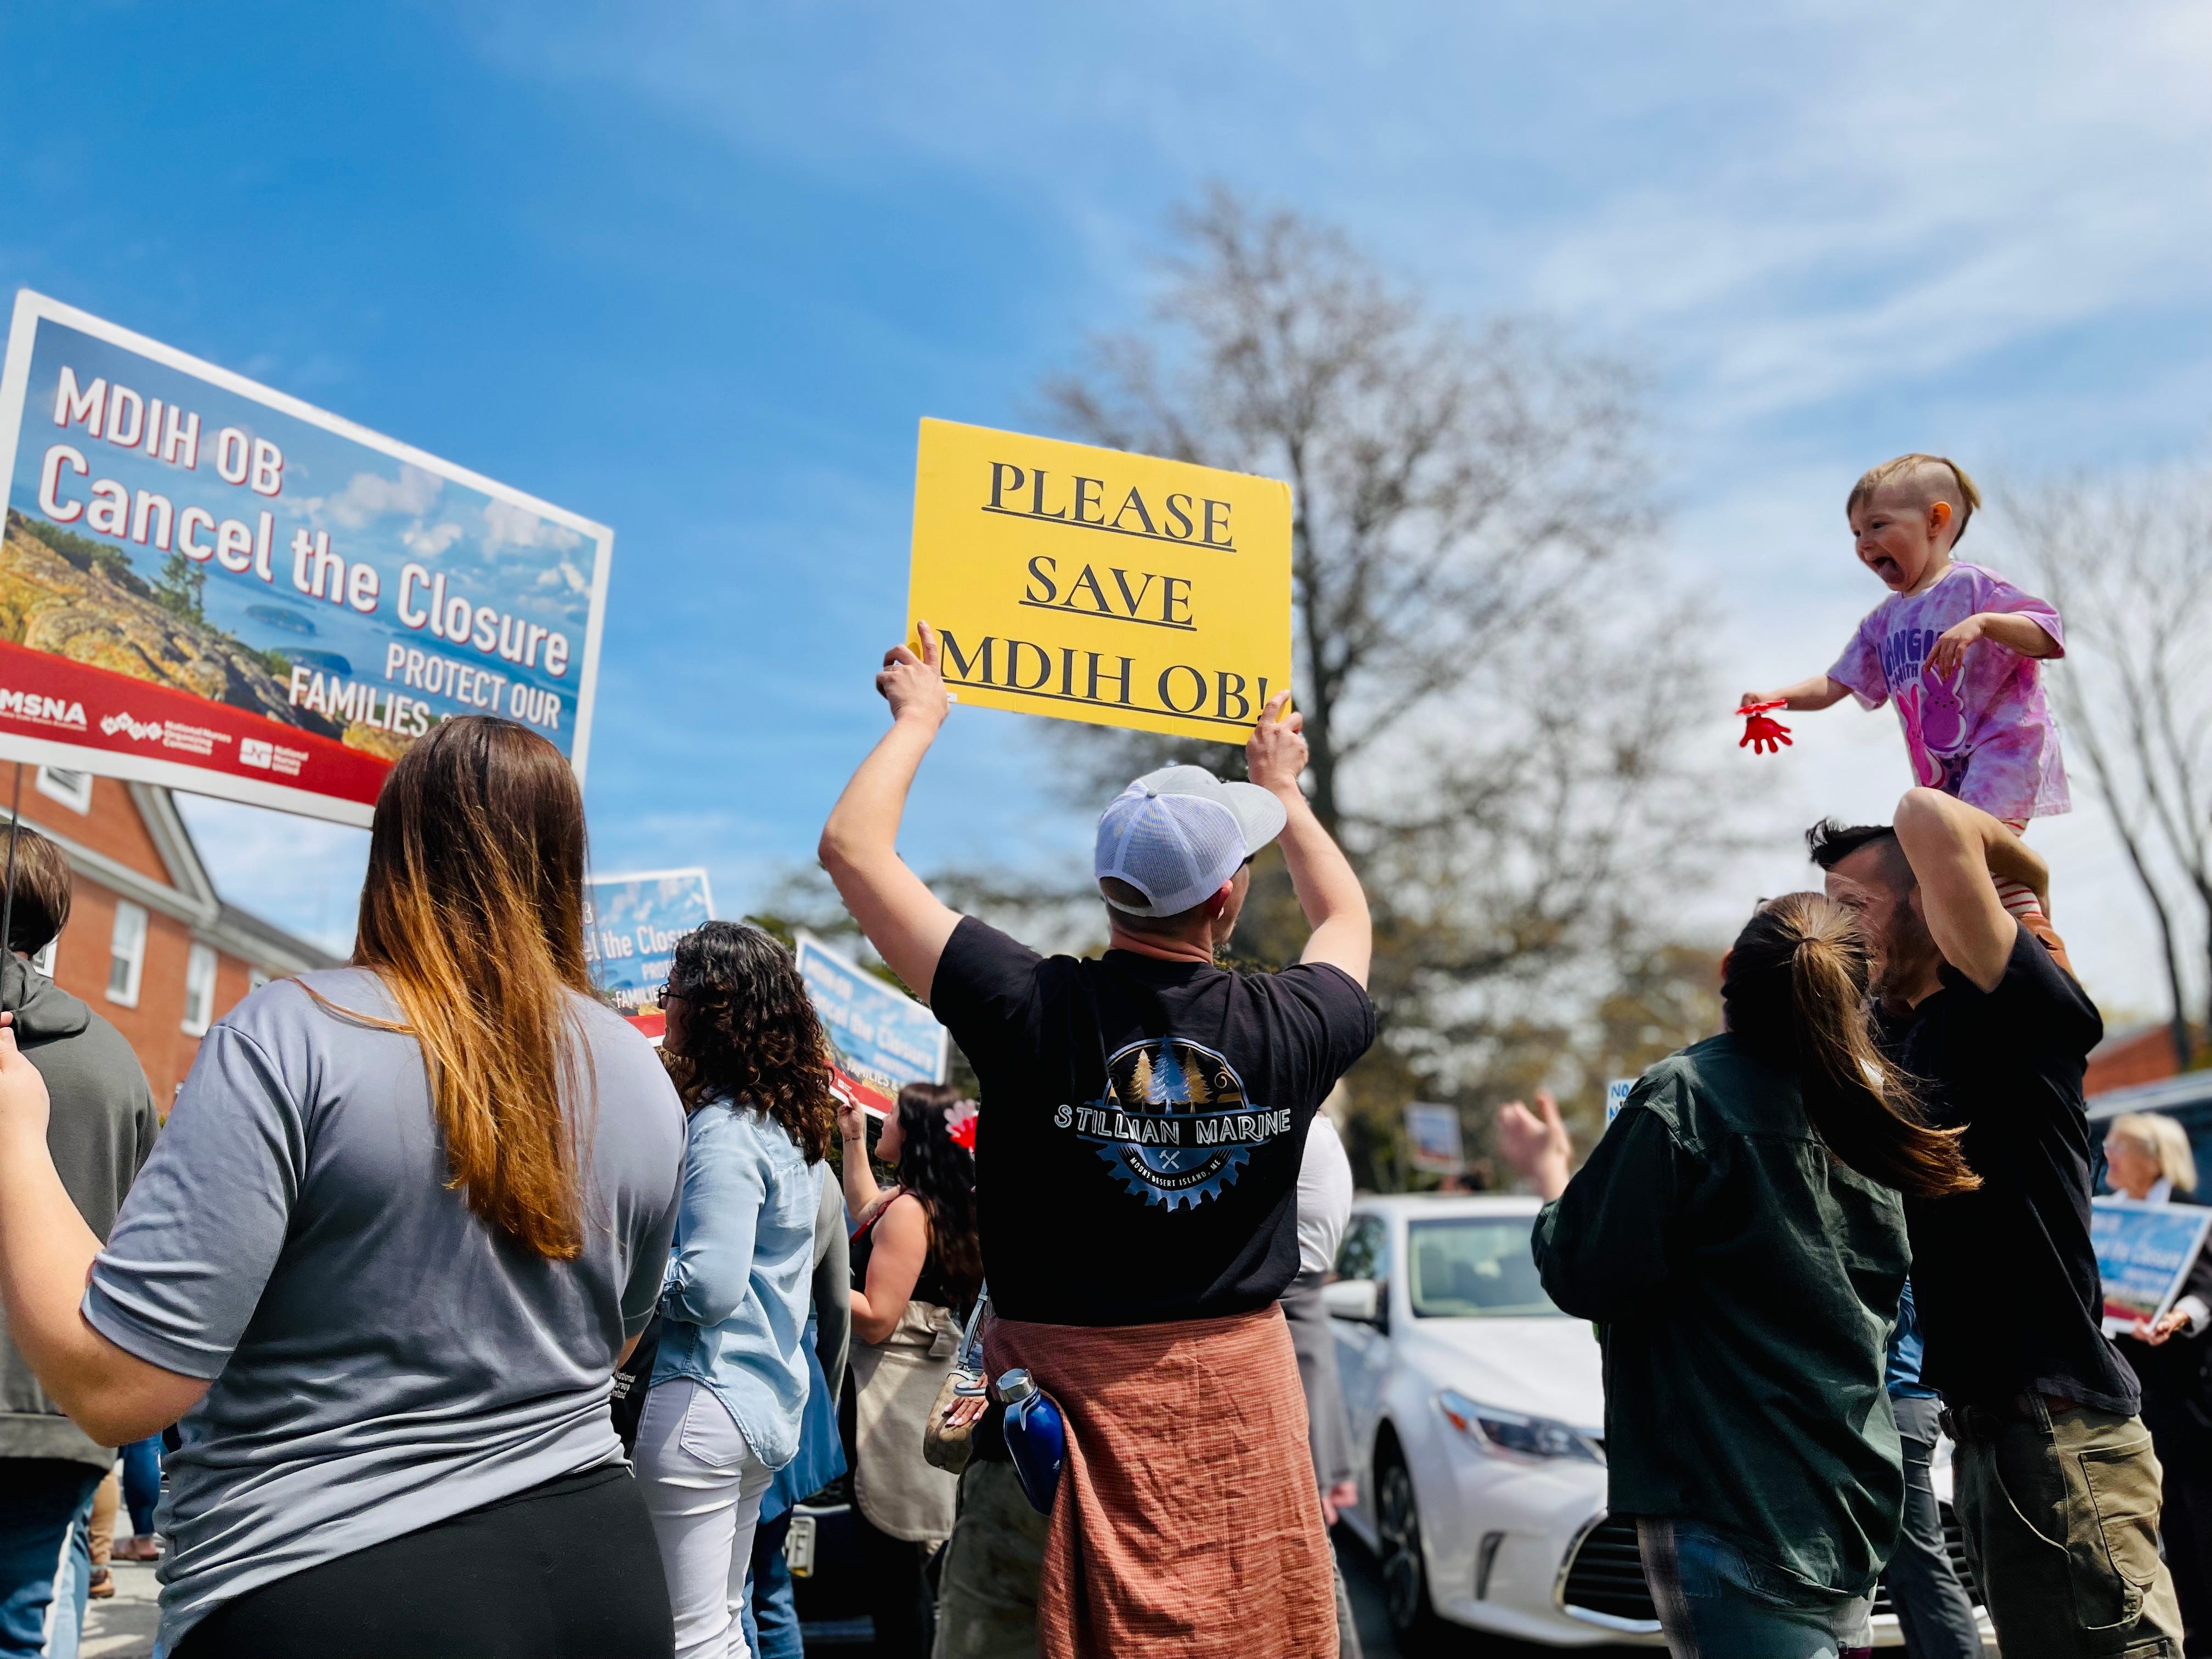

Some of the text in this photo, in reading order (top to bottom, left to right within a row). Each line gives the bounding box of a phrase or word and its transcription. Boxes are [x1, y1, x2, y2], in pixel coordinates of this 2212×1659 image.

[54, 365, 284, 497] MDIH OB
[988, 461, 1233, 548] PLEASE
[38, 444, 570, 678] Cancel the Closure
[1025, 555, 1193, 627] SAVE
[0, 688, 87, 725] MSNA
[289, 664, 431, 738] FAMILIES
[385, 641, 561, 731] PROTECT OUR
[936, 629, 1268, 722] MDIH OB!
[602, 929, 633, 960] the
[1195, 1108, 1291, 1146] MARINE
[1611, 1083, 1630, 1098] NO
[1152, 1175, 1176, 1187] DESERT
[1179, 1171, 1210, 1186] ISLAND,
[1210, 1159, 1221, 1170] ME
